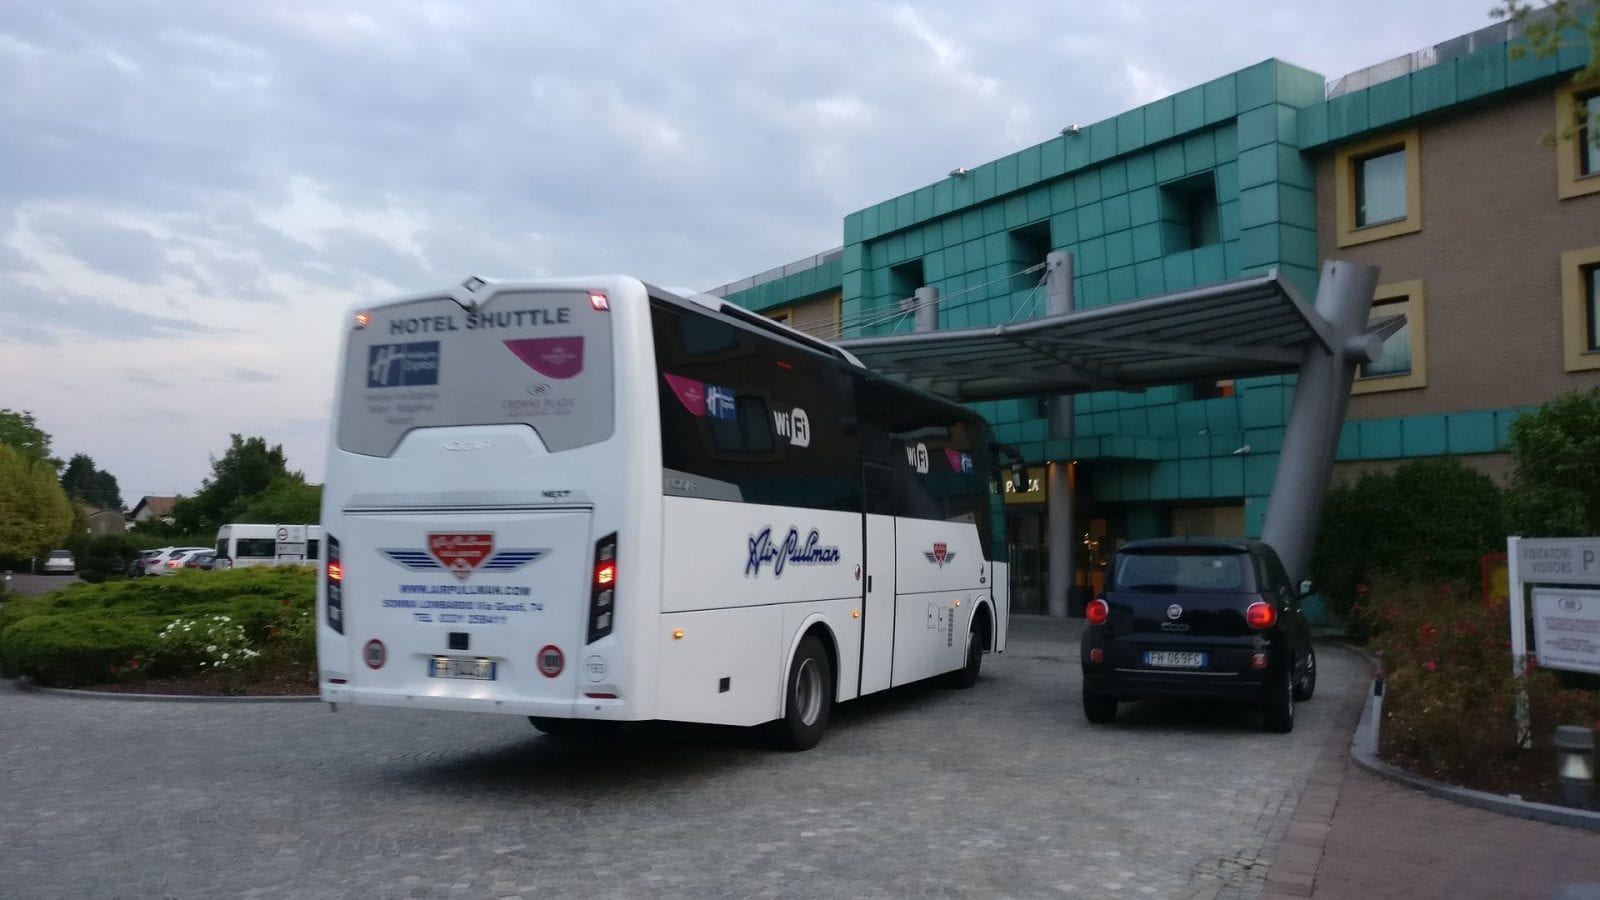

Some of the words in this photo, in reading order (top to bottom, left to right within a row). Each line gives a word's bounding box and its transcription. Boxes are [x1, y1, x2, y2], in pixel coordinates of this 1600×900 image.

[389, 315, 459, 336] HOTEL
[466, 307, 571, 331] SHUTTLE
[1583, 549, 1595, 572] P
